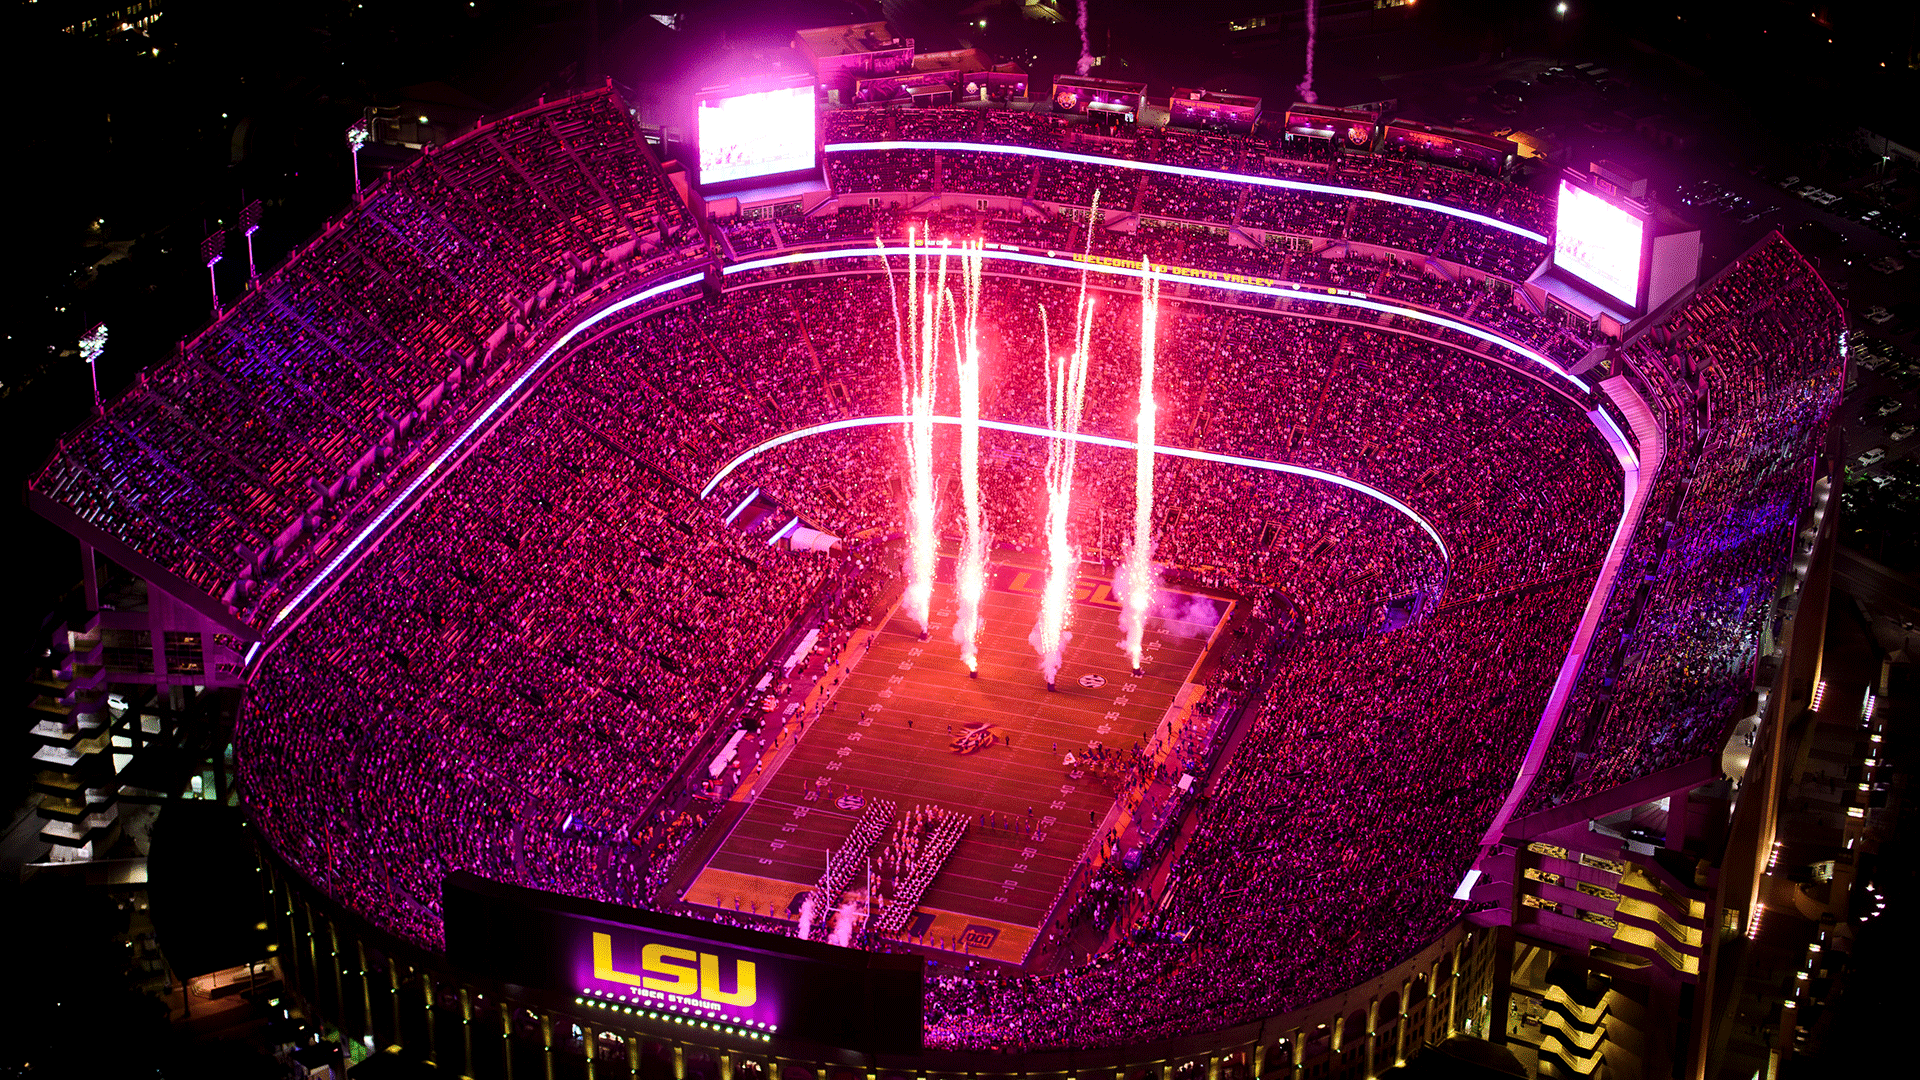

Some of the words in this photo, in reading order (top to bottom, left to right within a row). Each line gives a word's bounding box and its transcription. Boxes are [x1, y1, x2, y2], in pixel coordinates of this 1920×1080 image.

[1073, 253, 1143, 270] WELCOME
[1150, 263, 1168, 273] TO
[1172, 266, 1217, 280] DEATH
[1223, 273, 1274, 287] VALLEY
[1050, 800, 1066, 810] 35
[1041, 816, 1056, 826] 30
[782, 822, 798, 832] 15
[770, 838, 786, 848] 10
[1022, 847, 1038, 858] 20
[1012, 863, 1028, 873] 15
[1002, 880, 1018, 890] 10
[592, 931, 757, 1007] LSU
[630, 986, 664, 1000] TIGER
[668, 994, 721, 1011] STADIUM
